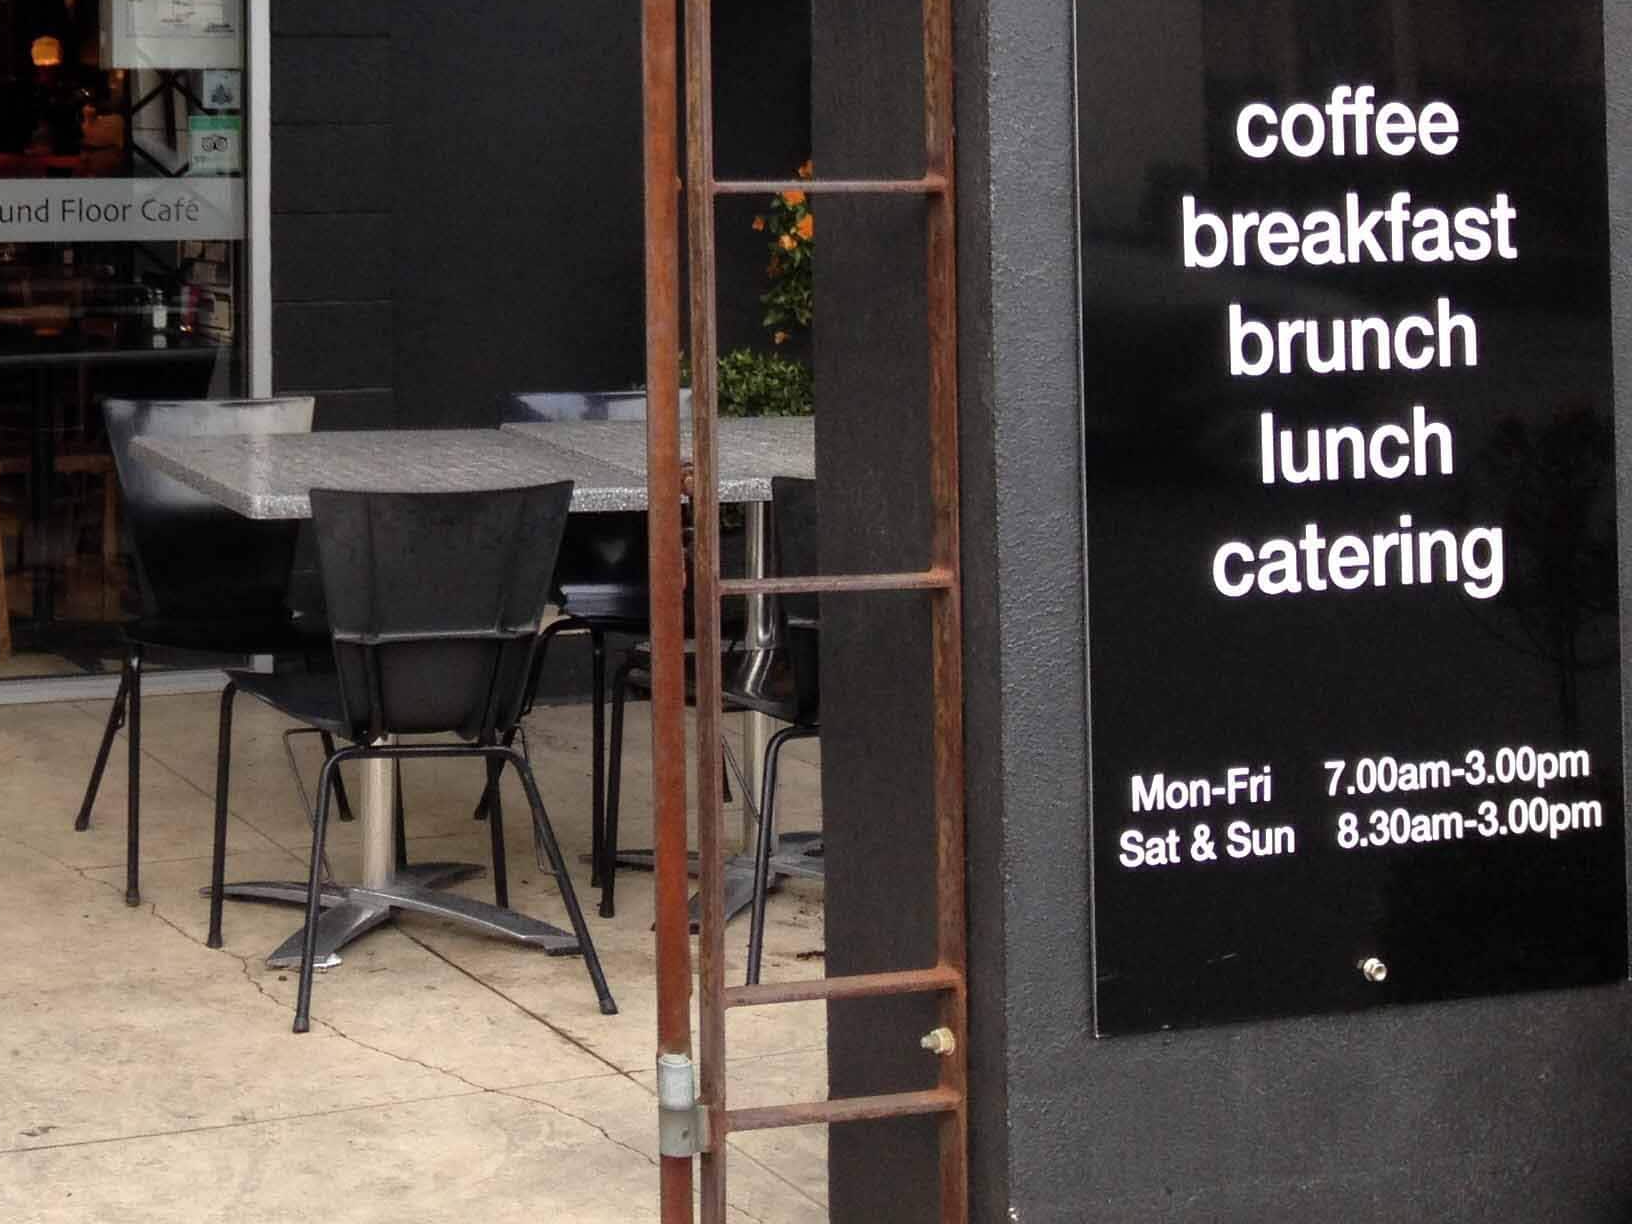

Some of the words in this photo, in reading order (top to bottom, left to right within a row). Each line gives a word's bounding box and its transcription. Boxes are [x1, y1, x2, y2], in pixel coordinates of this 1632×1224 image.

[1235, 84, 1460, 159] coffee
[61, 197, 133, 223] Floor
[1181, 191, 1518, 269] breakfast
[1228, 297, 1478, 377] brunch
[1260, 405, 1453, 484] lunch
[1212, 513, 1504, 599] catering
[1131, 765, 1272, 813] Mon-Fri
[1324, 745, 1591, 797] 7.00am-3.00pm
[1119, 828, 1181, 868] Sat
[1190, 823, 1218, 862] &
[1225, 820, 1296, 859] Sun
[1337, 797, 1603, 849] 8.30am-3.00pm
